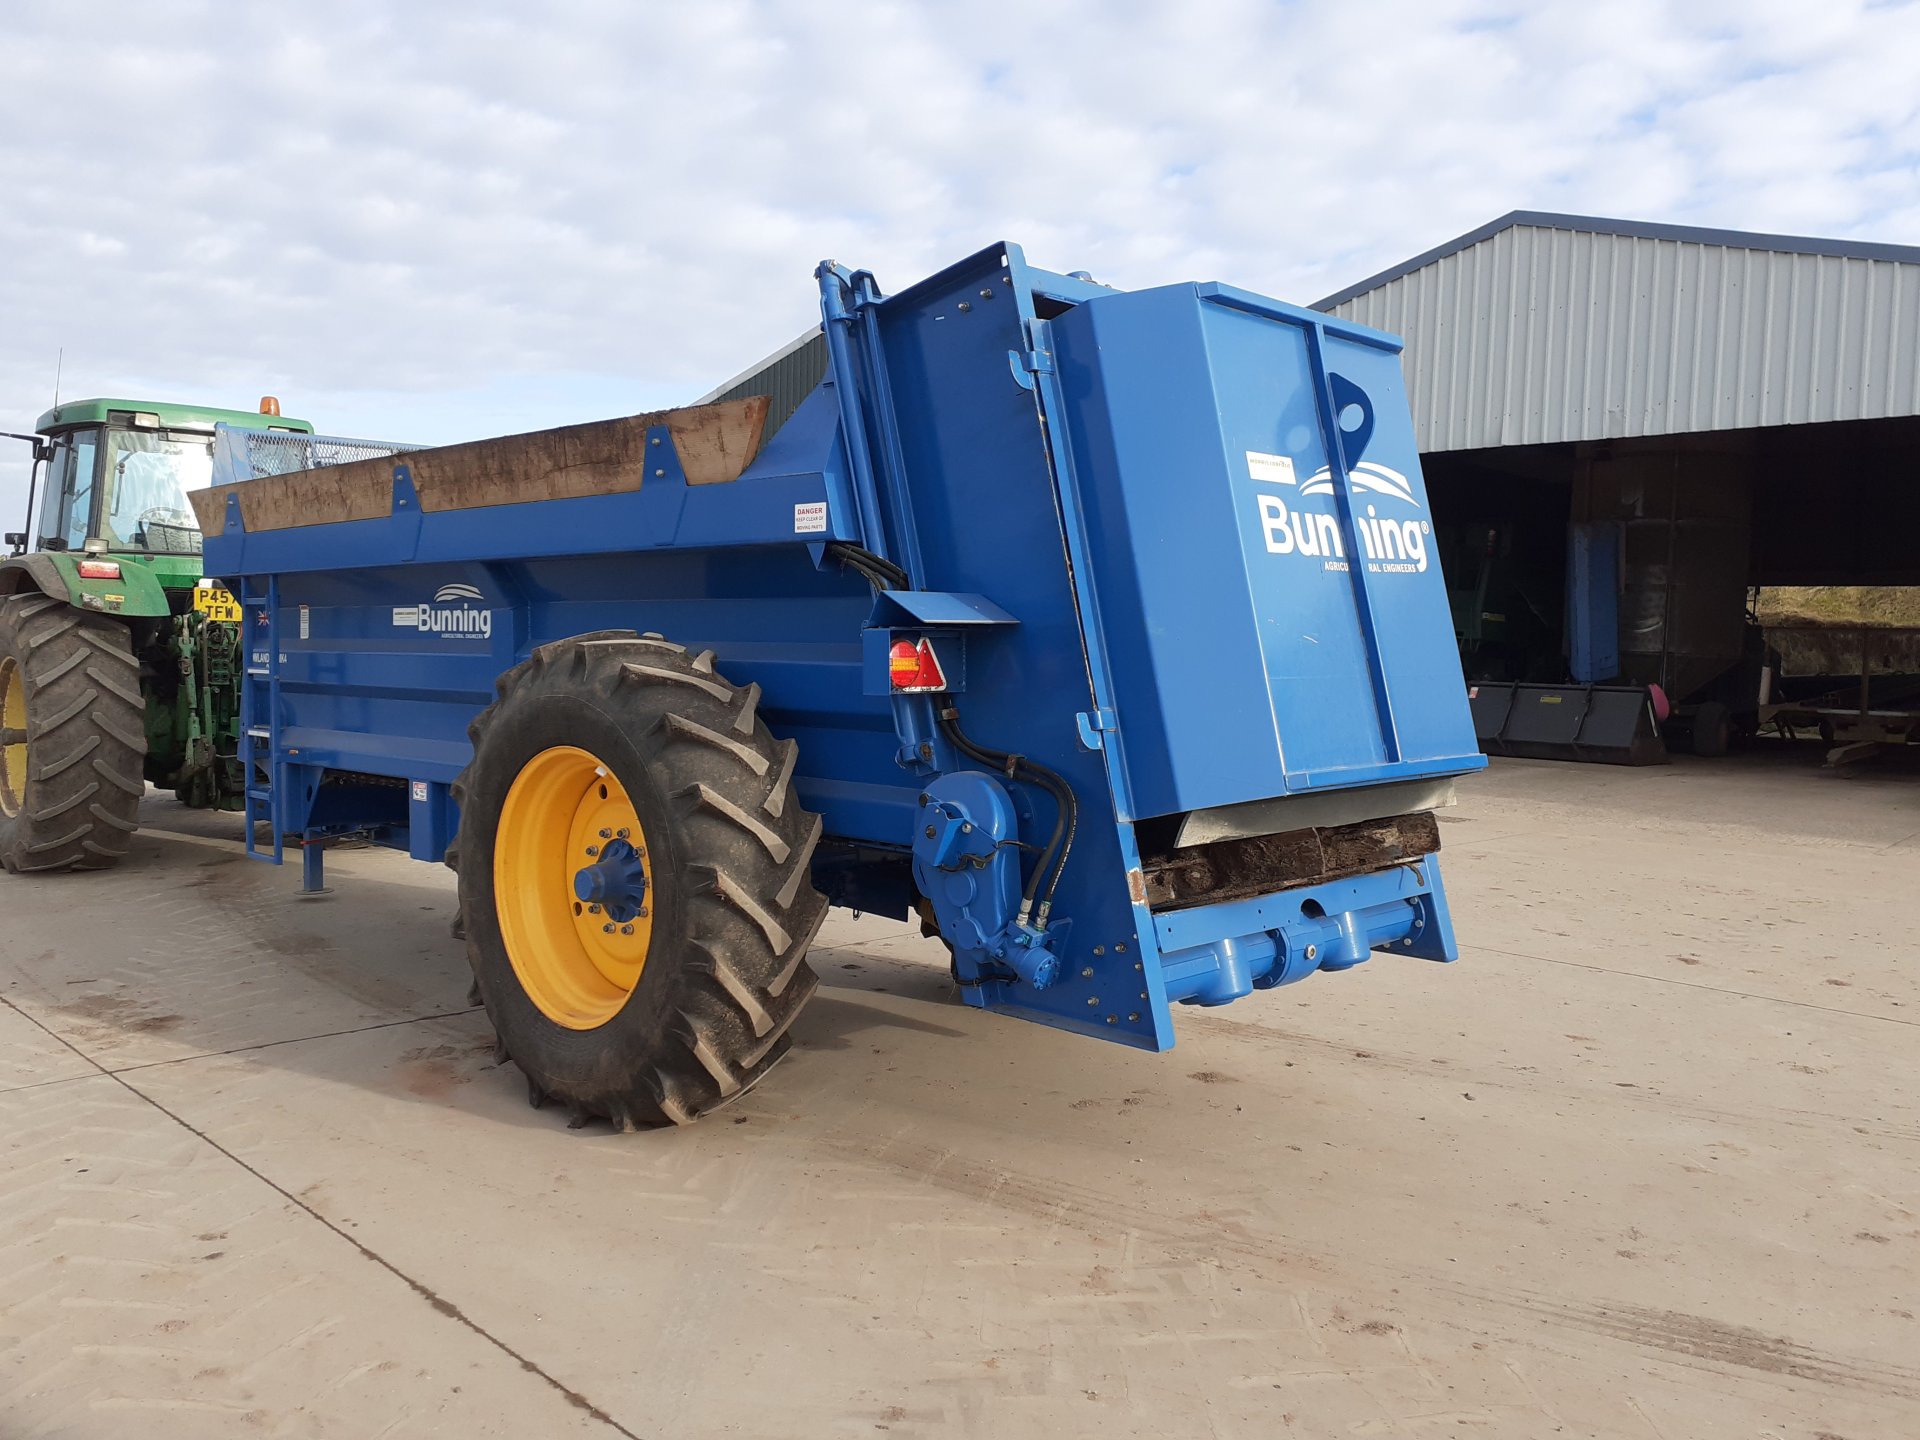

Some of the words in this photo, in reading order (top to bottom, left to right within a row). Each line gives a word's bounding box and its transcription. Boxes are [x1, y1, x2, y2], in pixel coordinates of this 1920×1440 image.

[1383, 562, 1417, 573] ENGINEERS
[205, 605, 234, 619] TFW
[418, 603, 491, 639] Bunning
